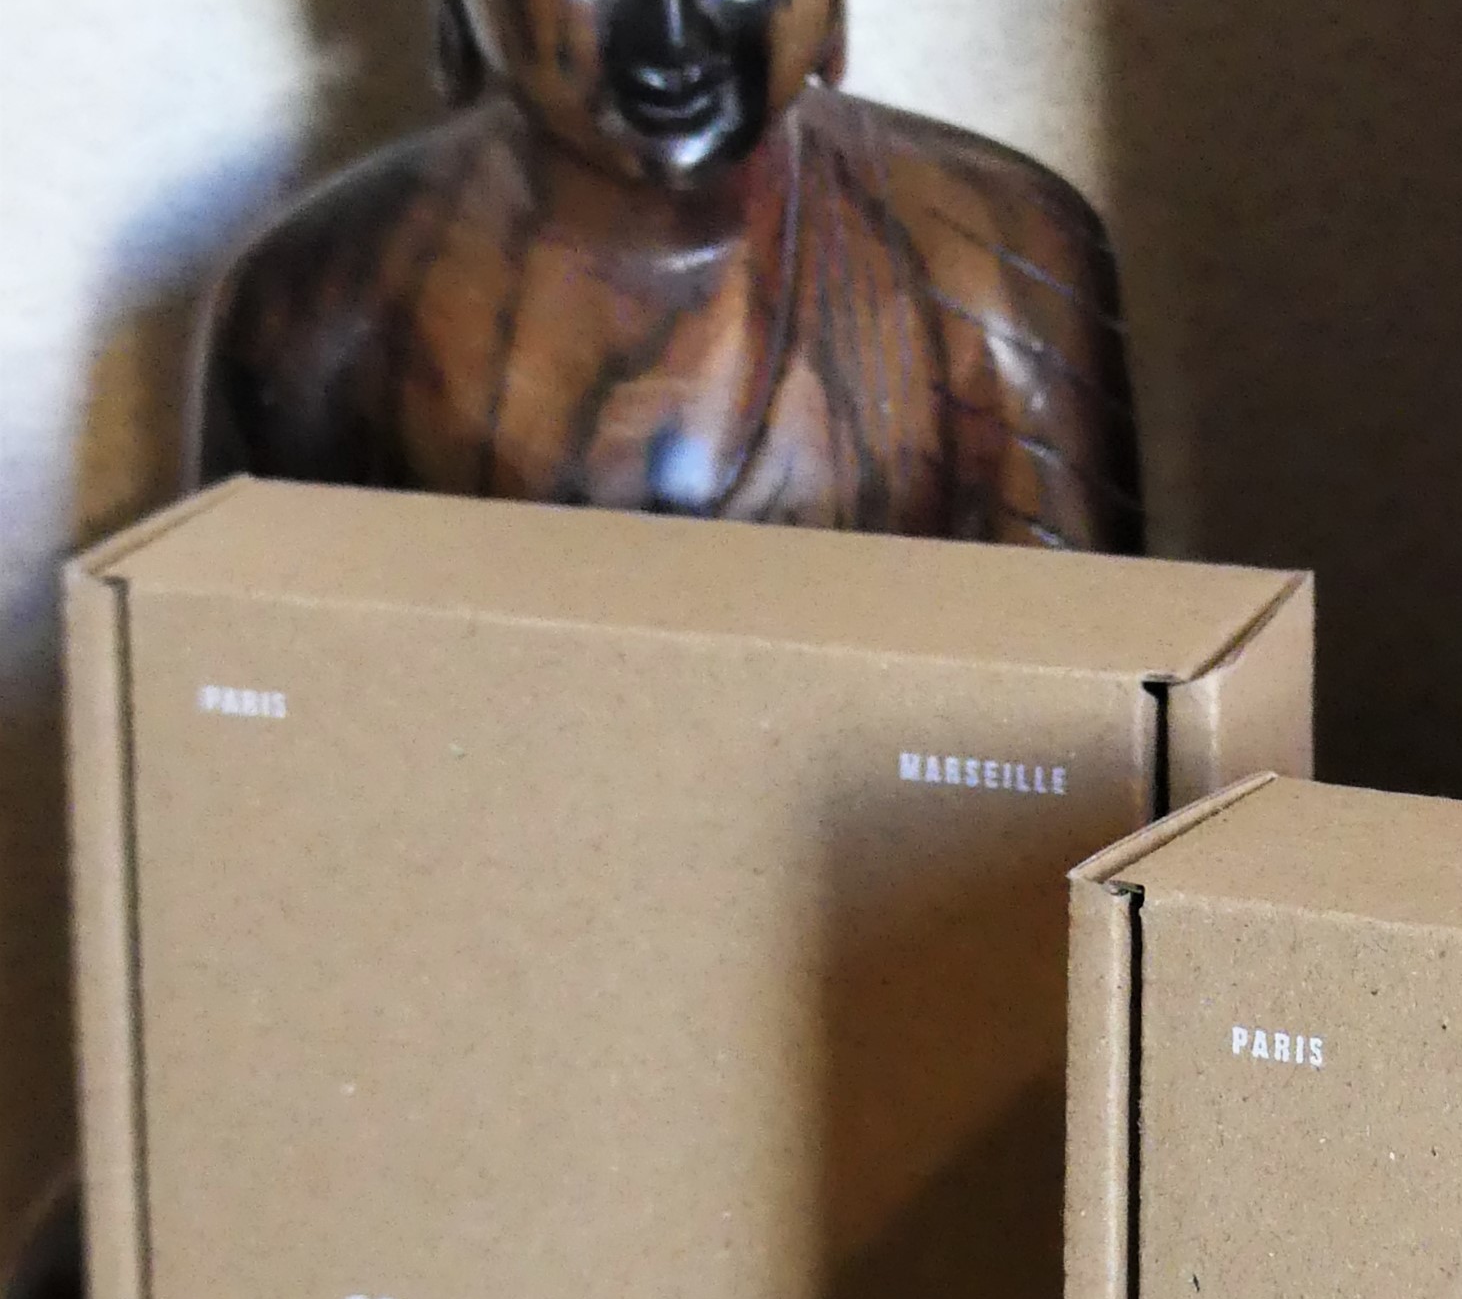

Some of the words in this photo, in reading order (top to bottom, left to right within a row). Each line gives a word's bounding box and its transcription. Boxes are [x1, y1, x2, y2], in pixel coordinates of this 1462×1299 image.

[198, 684, 287, 719] PARIS
[899, 752, 1067, 795] MARSEILLE
[1231, 1025, 1324, 1068] PARIS
